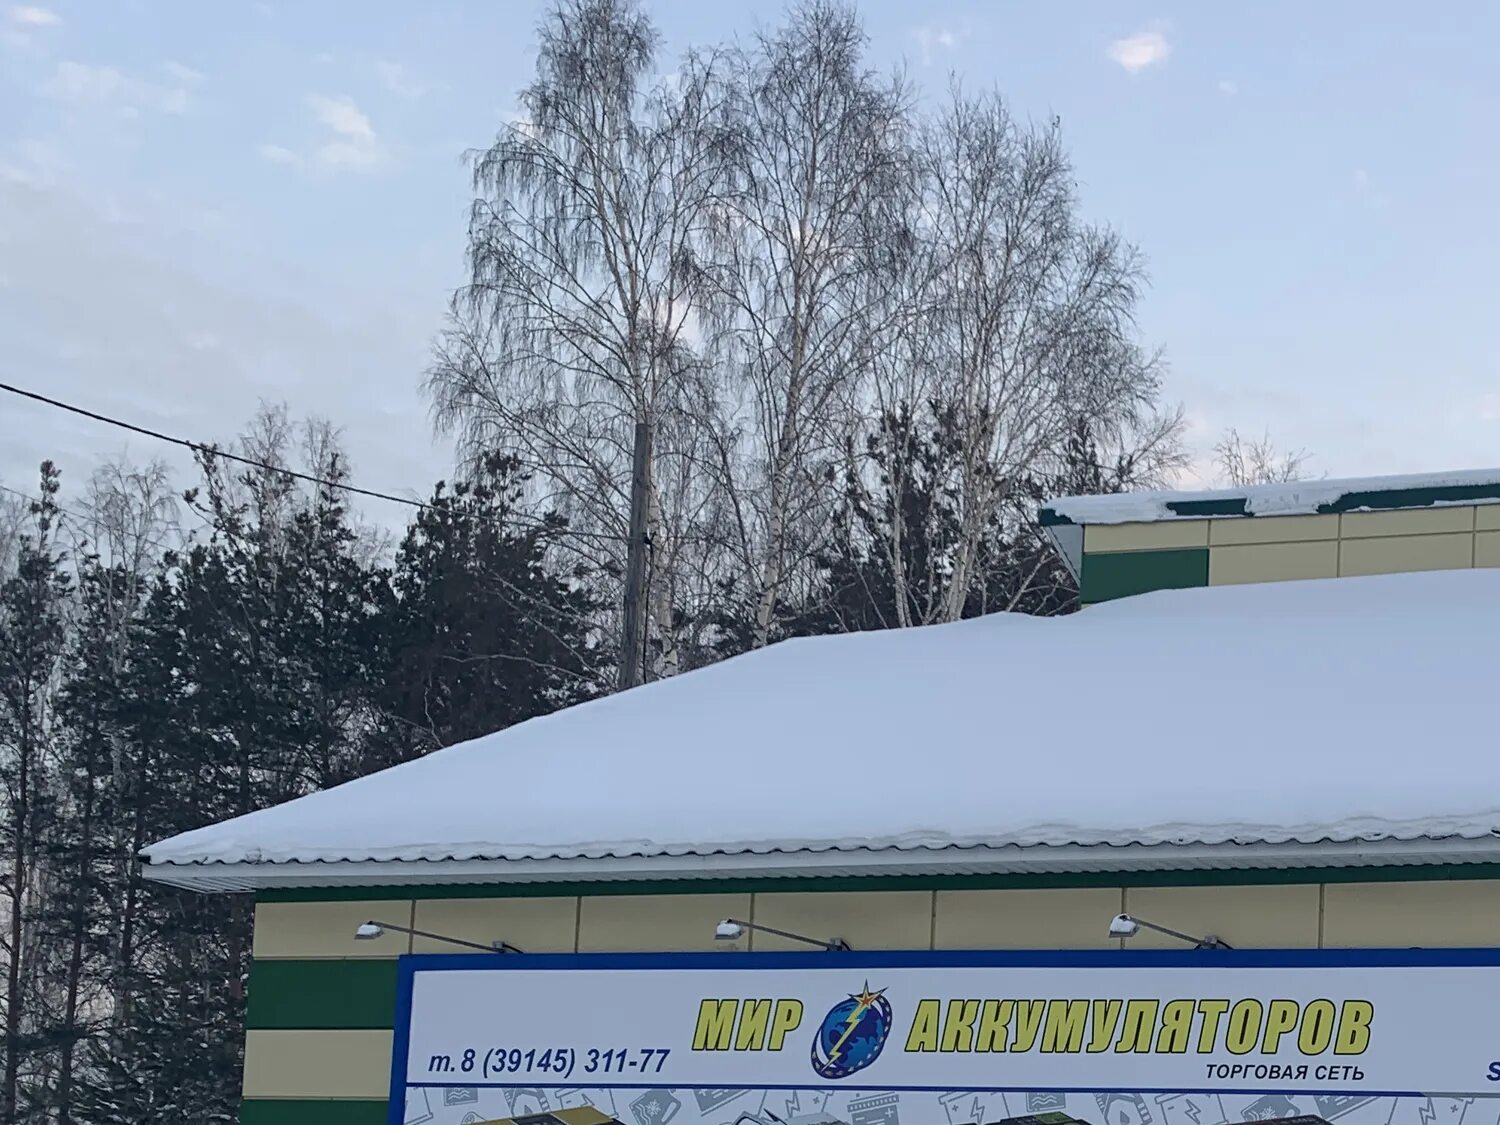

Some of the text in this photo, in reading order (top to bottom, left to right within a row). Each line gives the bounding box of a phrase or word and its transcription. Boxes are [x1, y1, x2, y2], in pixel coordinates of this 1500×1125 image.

[693, 998, 1374, 1055] МИР АККУМУЛЯТОРОВ
[461, 1048, 477, 1072] 8
[483, 1048, 575, 1079] (39145)
[585, 1048, 671, 1072] 311-77
[1206, 1063, 1366, 1082] ТОРГОВАЯ СЕТЬ
